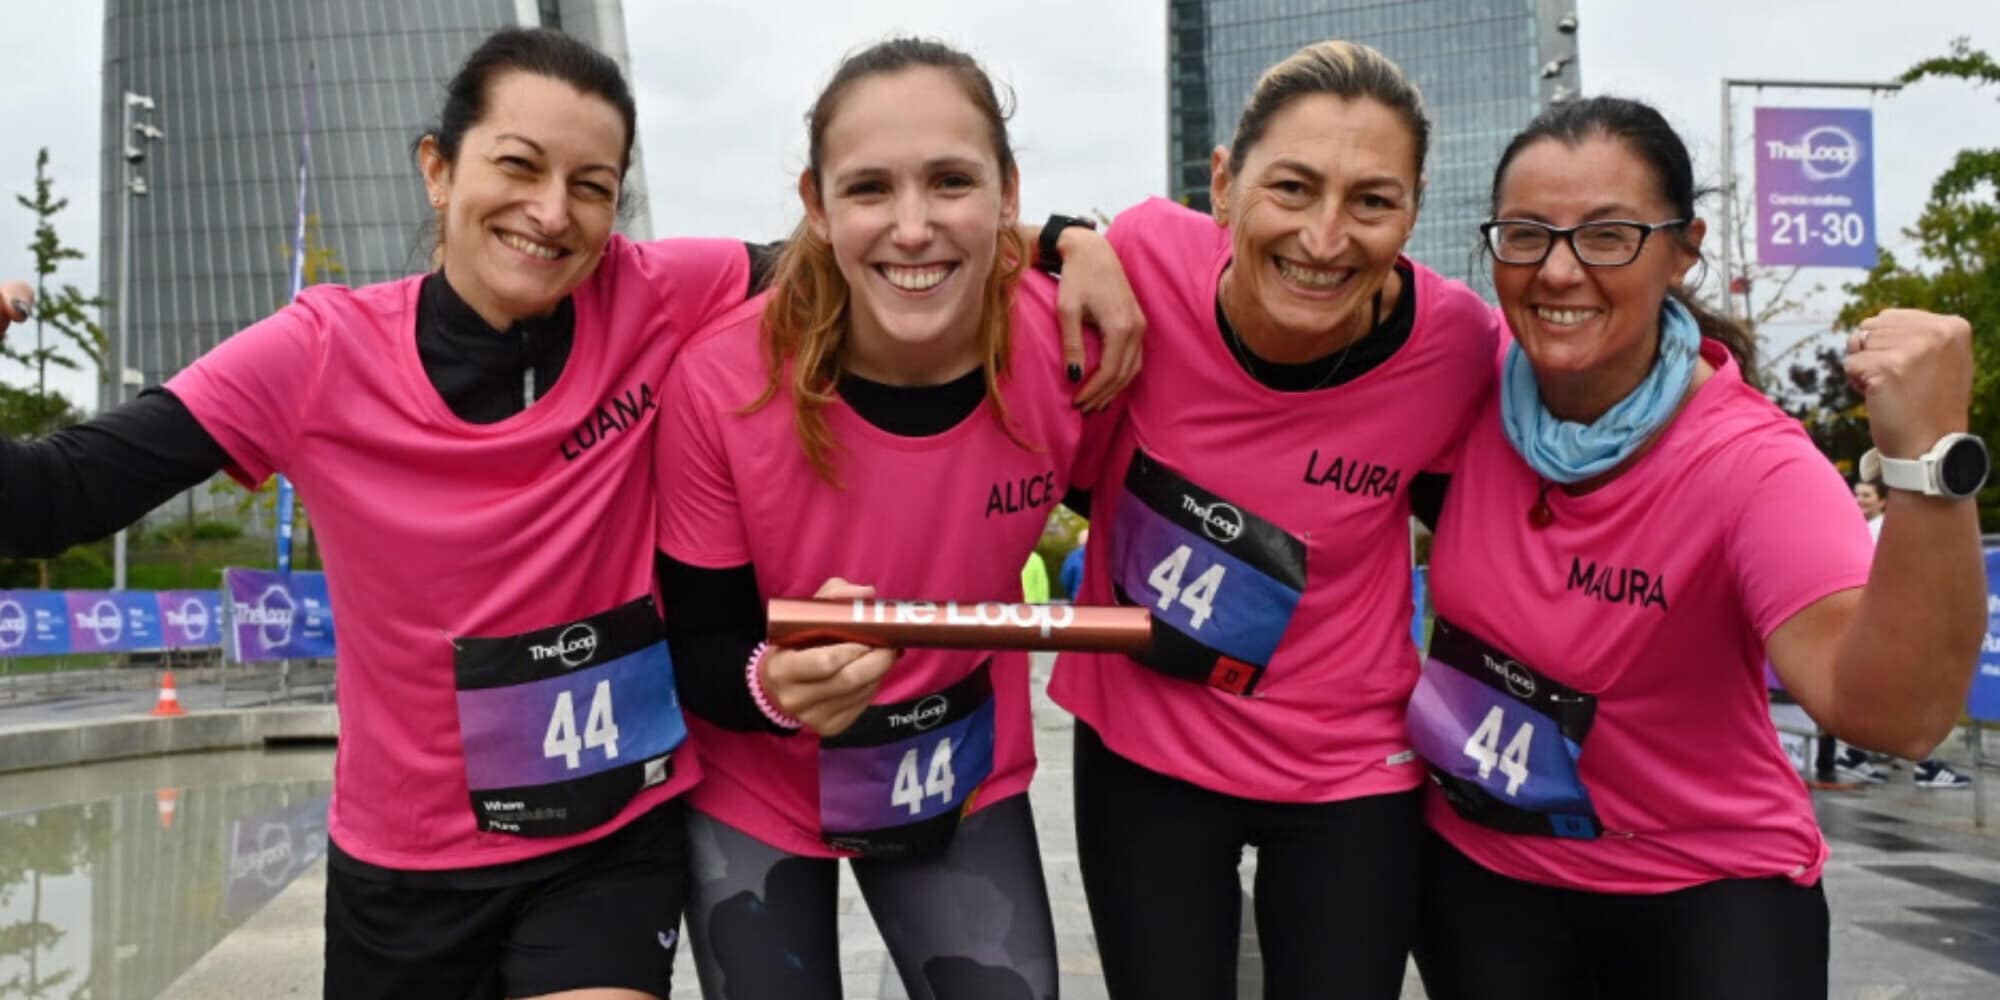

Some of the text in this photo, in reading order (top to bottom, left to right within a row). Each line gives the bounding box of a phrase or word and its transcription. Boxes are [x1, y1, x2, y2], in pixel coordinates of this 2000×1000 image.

[1770, 211, 1865, 247] 21-30
[560, 382, 657, 461] LUANA
[985, 471, 1054, 519] ALICE
[1303, 450, 1401, 498] LAURA
[1148, 544, 1227, 630] 44
[1567, 556, 1668, 612] MAURA
[947, 600, 1075, 638] Loop
[543, 679, 620, 769] 44
[1463, 705, 1535, 797] 44
[890, 737, 956, 815] 44
